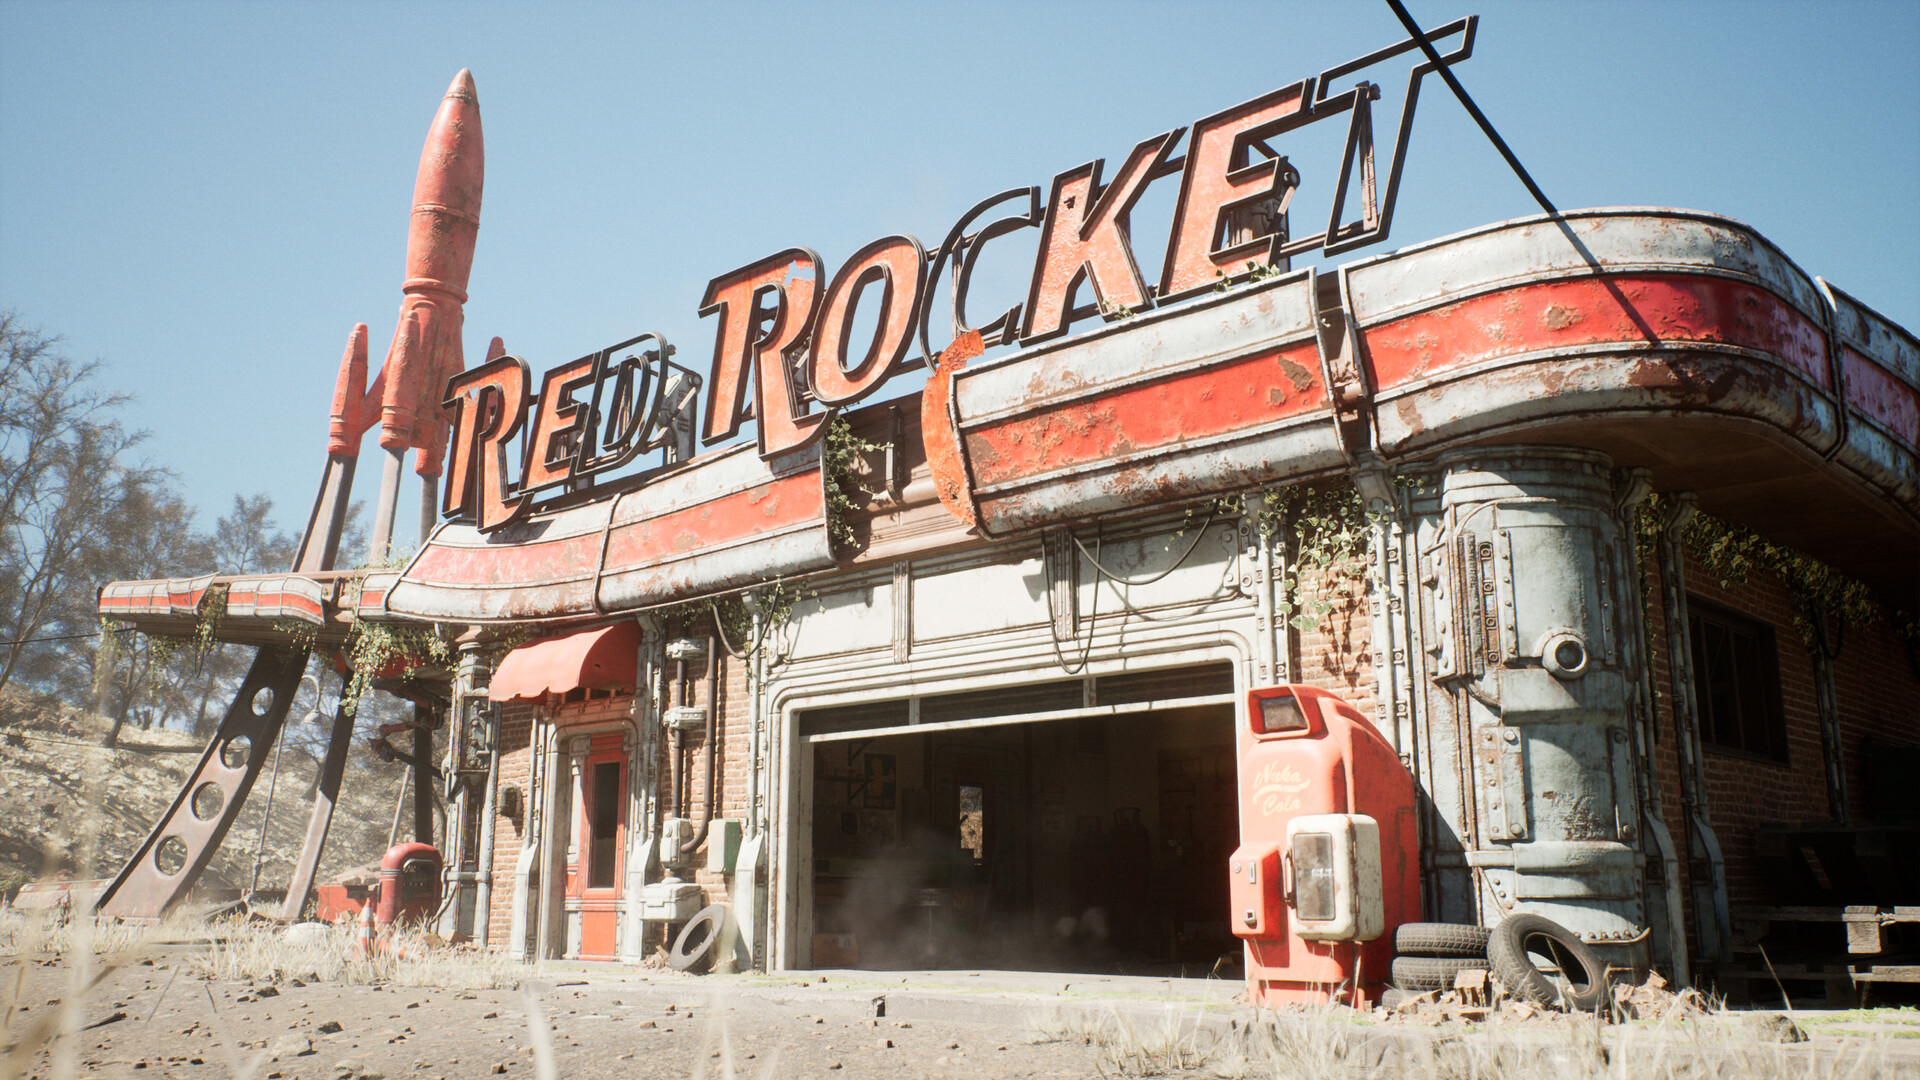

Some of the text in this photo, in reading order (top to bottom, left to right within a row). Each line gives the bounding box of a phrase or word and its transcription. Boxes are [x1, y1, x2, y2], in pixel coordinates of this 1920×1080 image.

[442, 15, 1479, 534] RED ROCKET
[1253, 759, 1303, 789] Nuka
[1263, 793, 1301, 816] Cola
